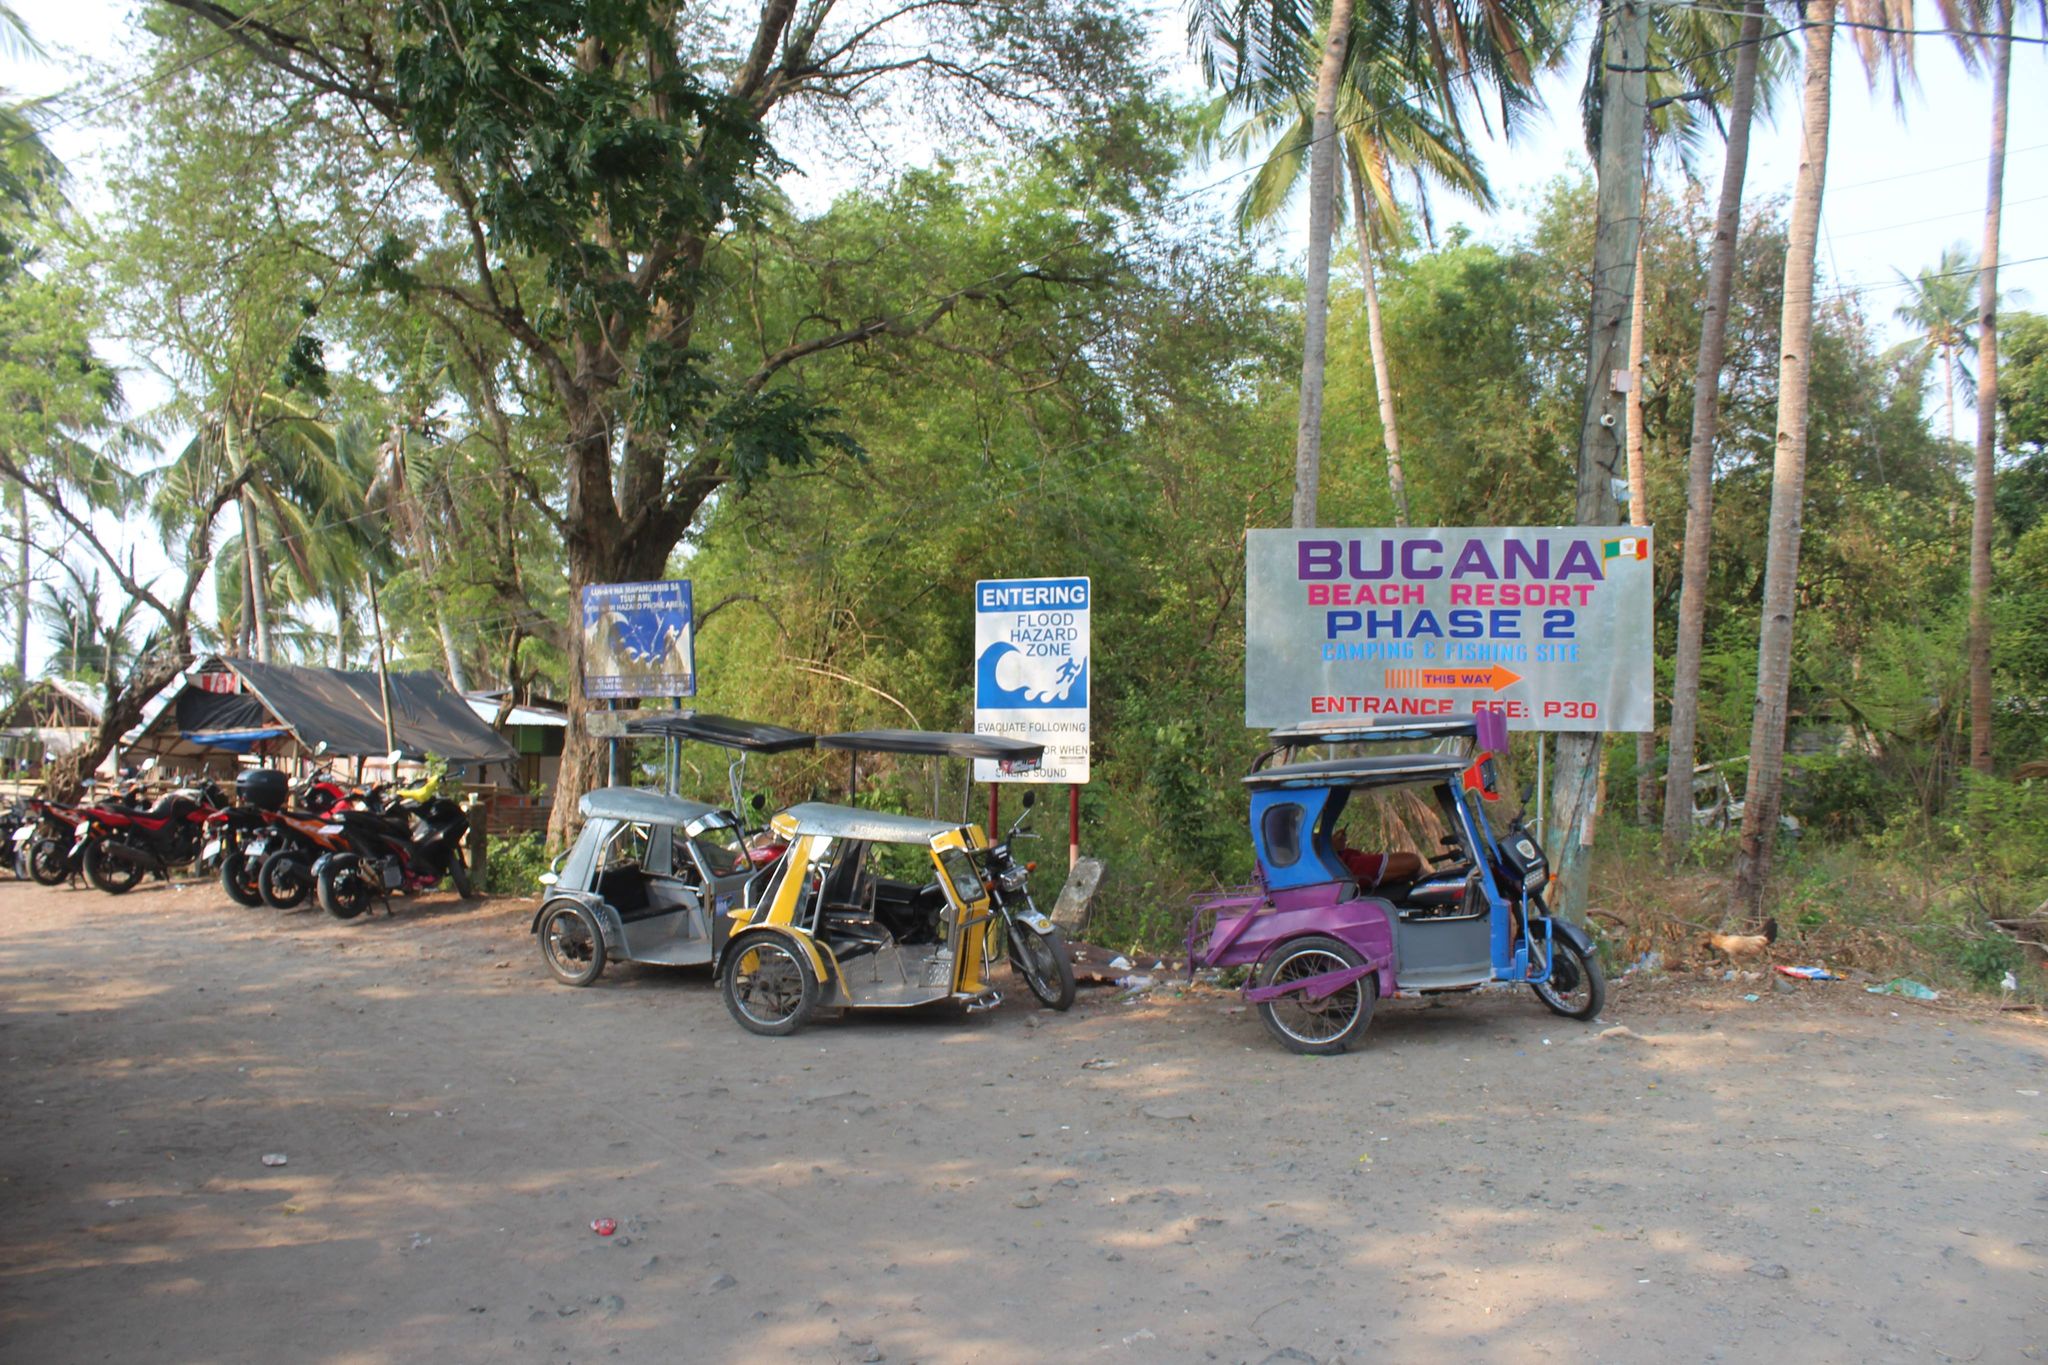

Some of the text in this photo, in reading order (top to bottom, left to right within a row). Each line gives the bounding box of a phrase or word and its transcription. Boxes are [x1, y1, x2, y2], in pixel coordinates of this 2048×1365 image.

[1298, 538, 1605, 581] BUCANA
[982, 586, 1086, 607] ENTERING
[1307, 583, 1595, 607] BEACH RESORT
[1017, 612, 1074, 628] FLOOD
[1326, 609, 1576, 639] PHASE 2
[1010, 627, 1078, 643] HAZARD
[1026, 642, 1071, 657] ZONE
[1321, 641, 1581, 663] CAMPING & FISHING SITE
[1424, 673, 1493, 685] THIS WAY
[1310, 696, 1454, 715] ENTRANCE
[1543, 701, 1598, 719] P30
[977, 722, 1086, 733] EVACUATE FOLLOWING
[1059, 745, 1088, 755] WHEN
[1033, 767, 1067, 778] SOUND
